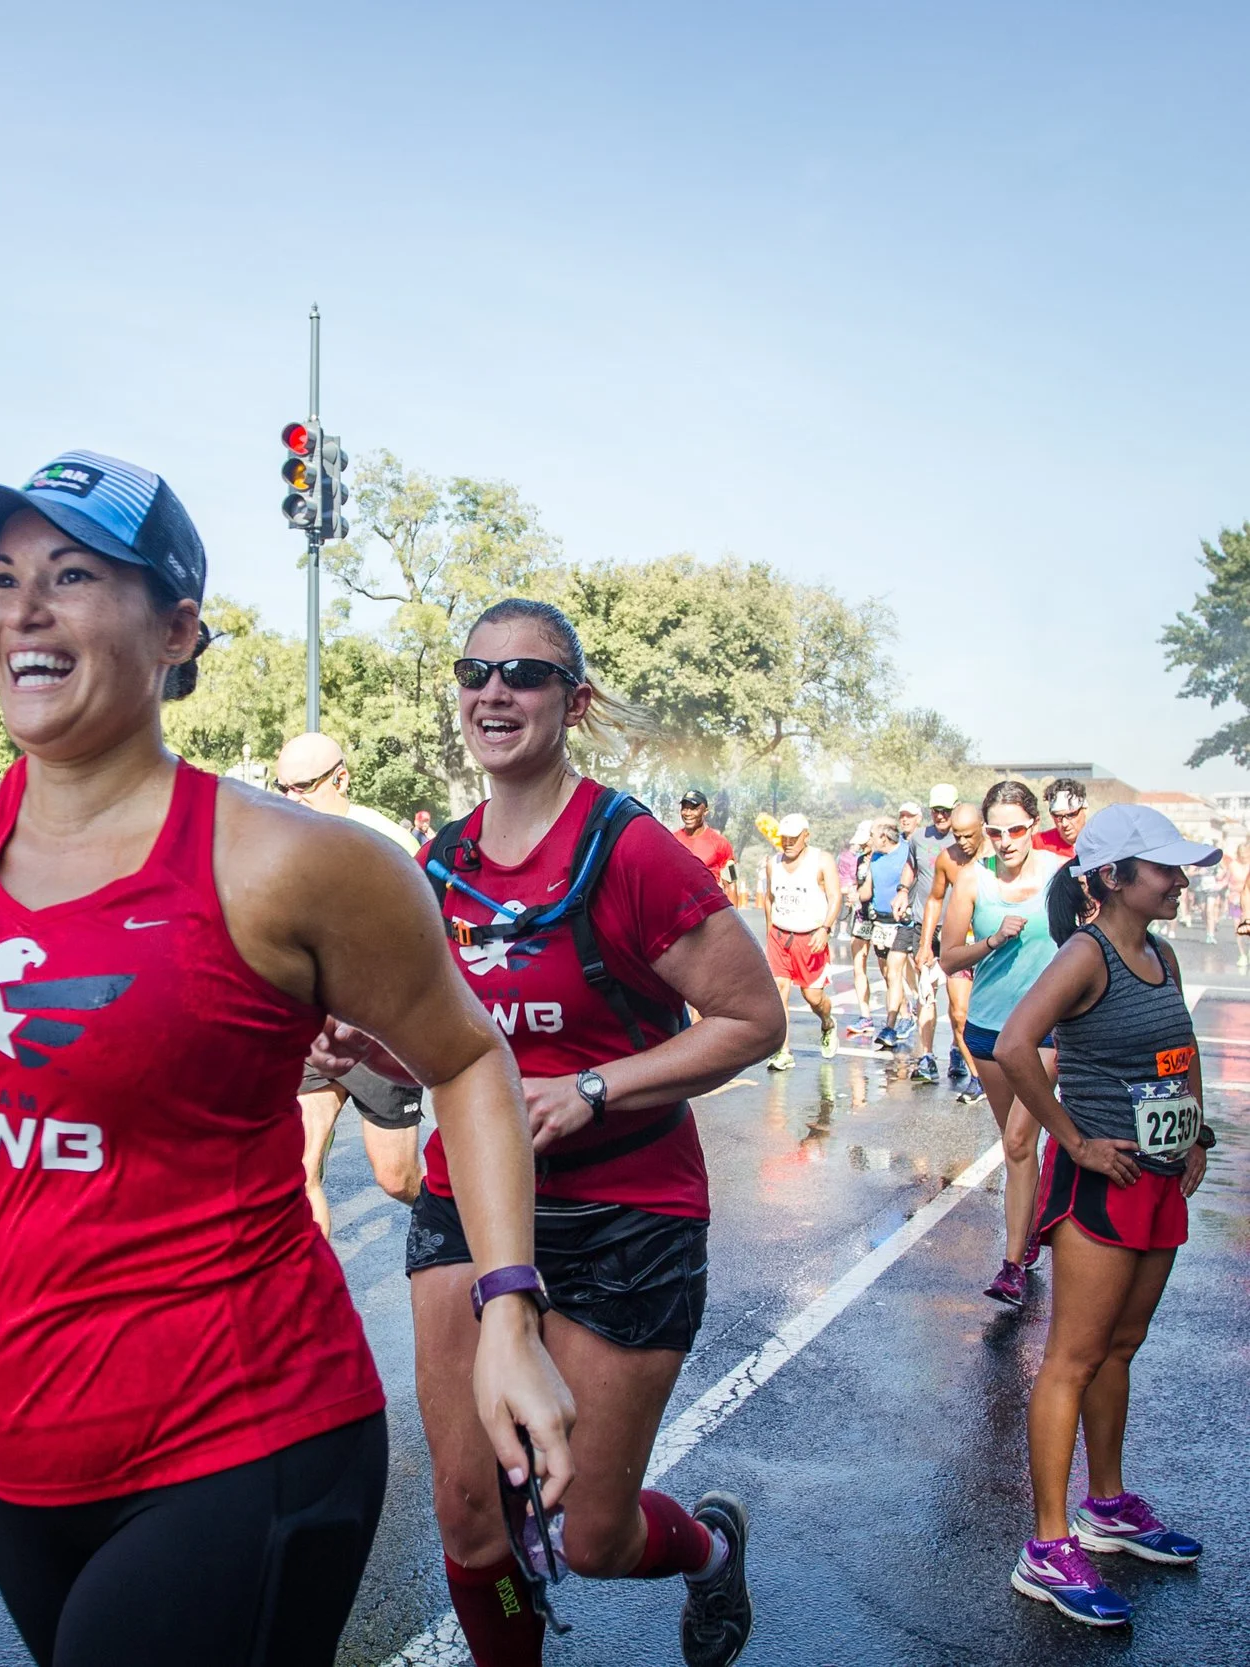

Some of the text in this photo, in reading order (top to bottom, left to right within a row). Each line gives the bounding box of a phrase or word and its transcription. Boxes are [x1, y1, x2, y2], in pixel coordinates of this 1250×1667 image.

[491, 1002, 564, 1035] WB
[1146, 1104, 1198, 1146] 22531
[494, 1575, 521, 1618] ZENSAH
